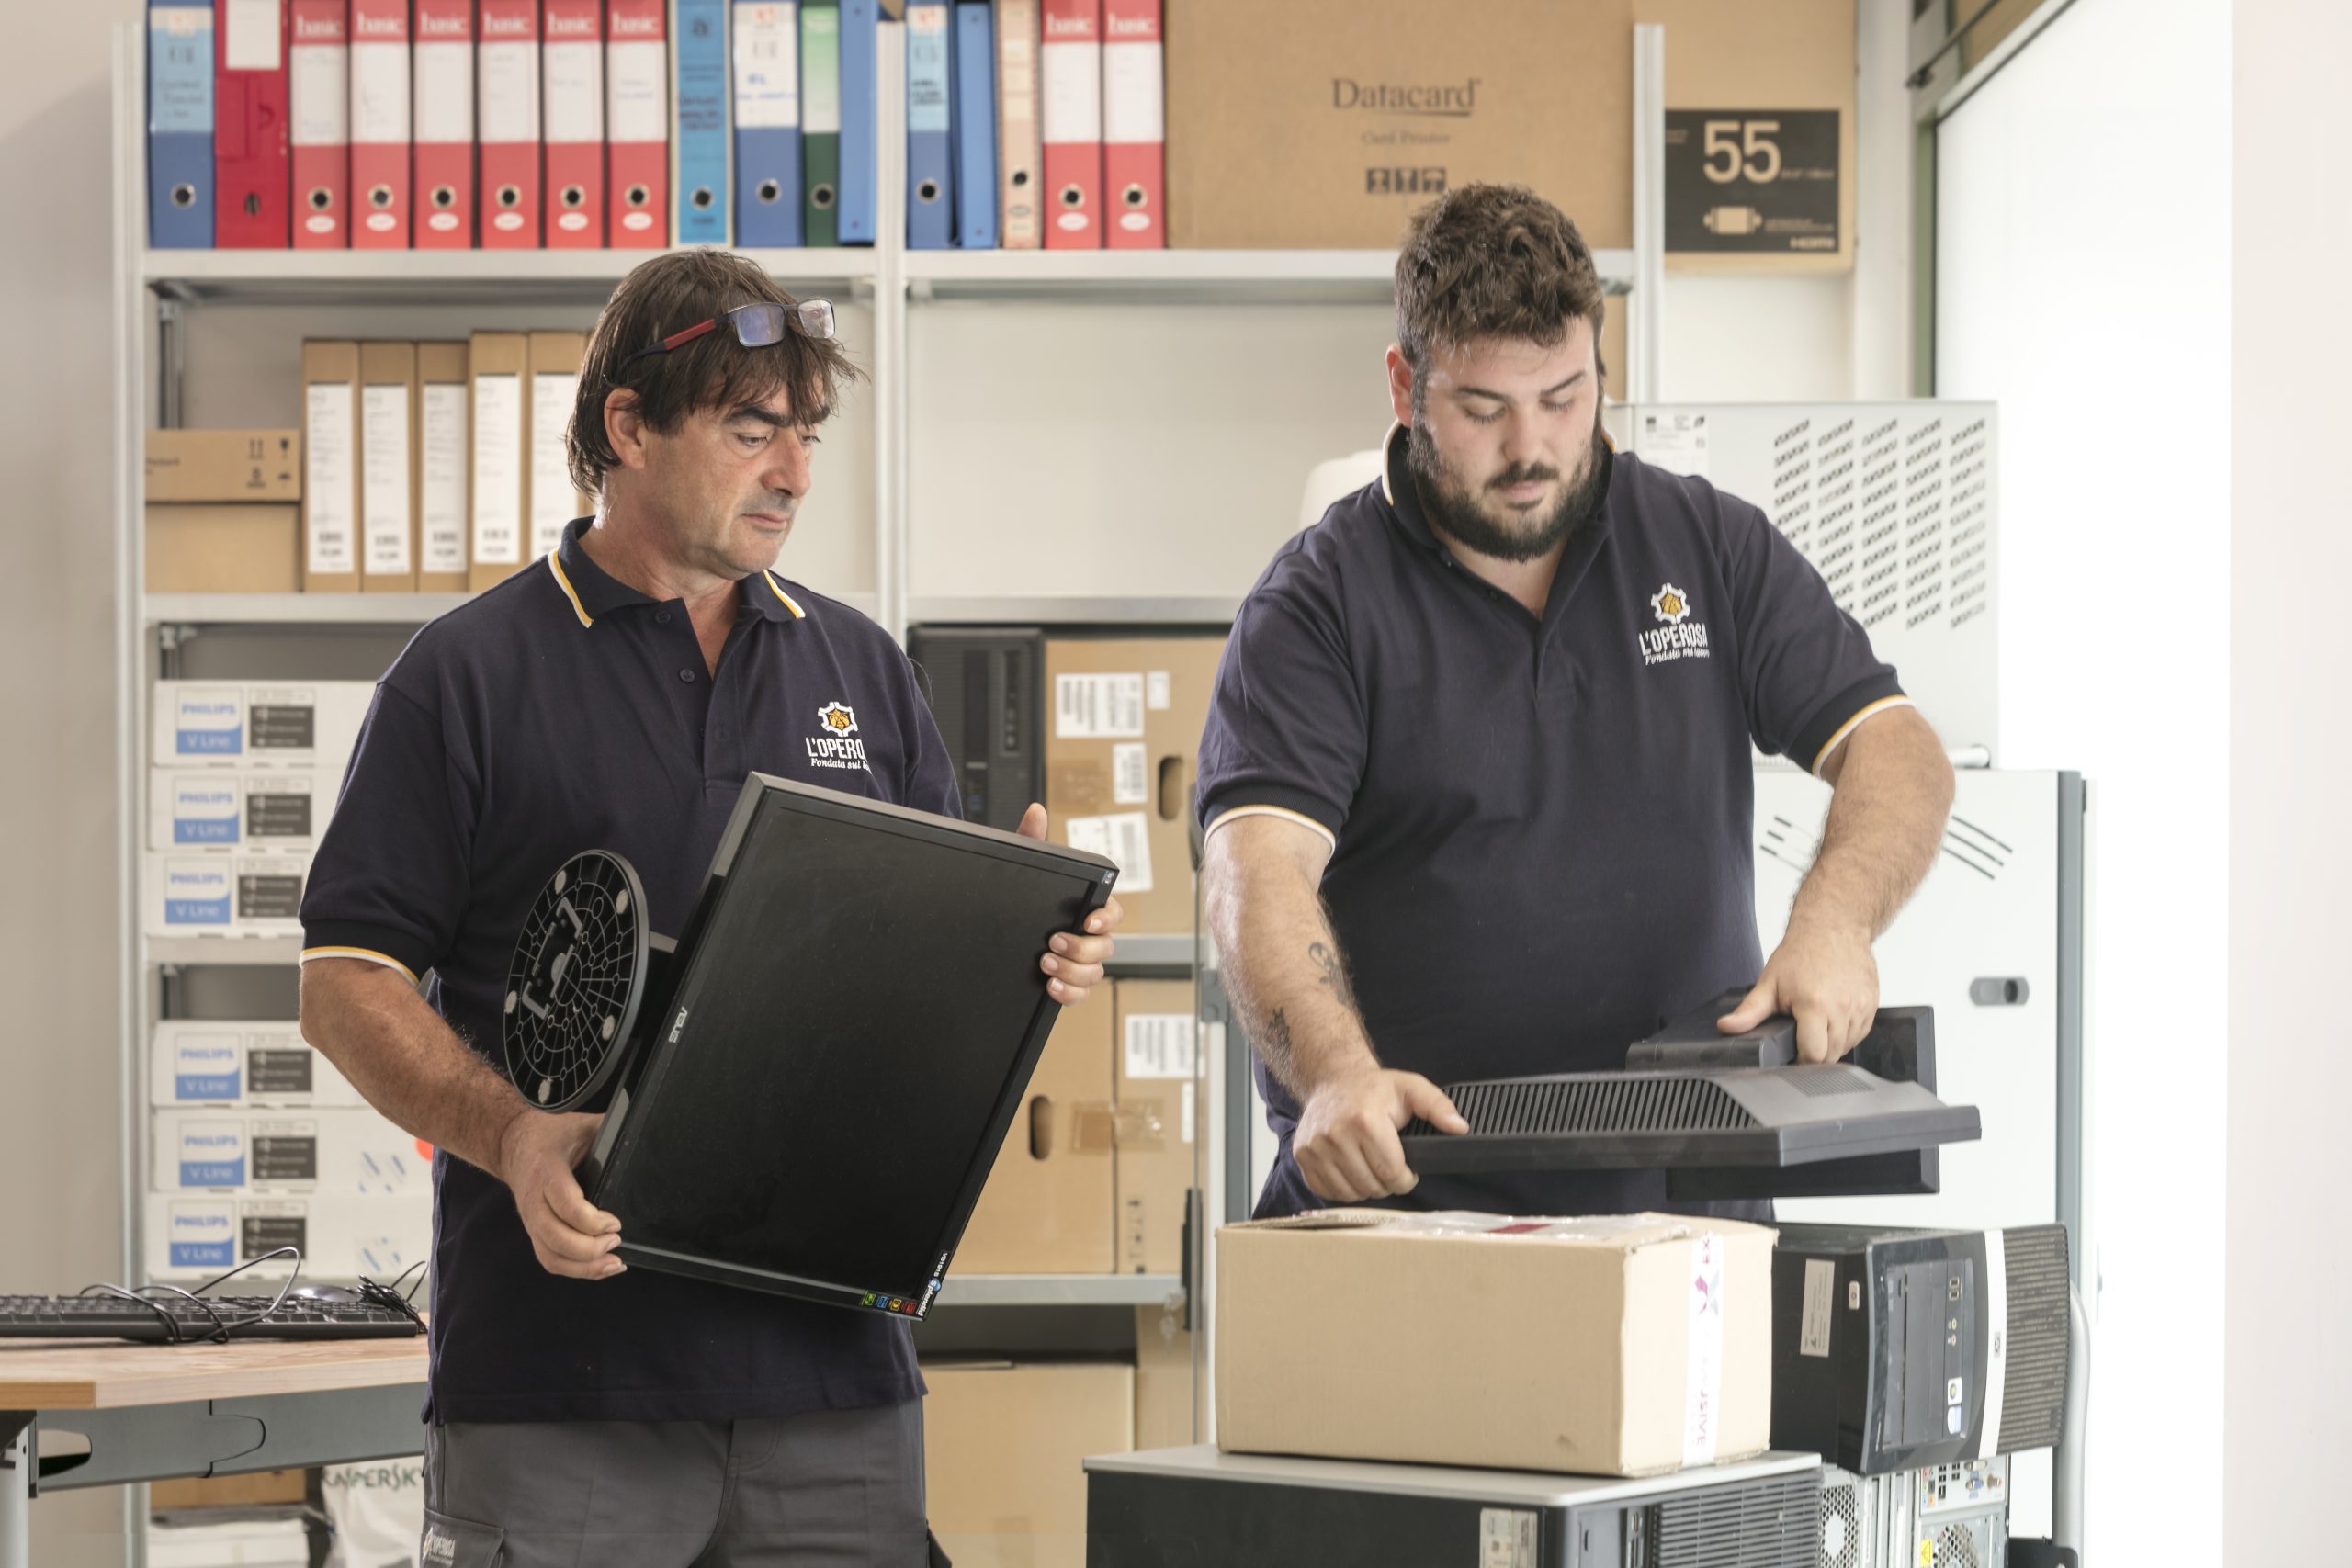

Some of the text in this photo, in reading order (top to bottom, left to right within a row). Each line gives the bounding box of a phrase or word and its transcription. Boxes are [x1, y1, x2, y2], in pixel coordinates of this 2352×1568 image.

[1331, 76, 1476, 110] Datacard
[1703, 120, 1781, 184] 55
[1638, 622, 1709, 657] L'OPEROSA
[182, 703, 236, 716] PHILIPS
[186, 734, 231, 749] V Line
[805, 737, 865, 760] L'OPERO
[810, 758, 846, 769] Fondata
[847, 761, 862, 770] sul
[179, 792, 233, 805] PHILIPS
[184, 823, 229, 837] V Line
[170, 873, 224, 886] PHILIPS
[175, 903, 220, 917] V Line
[668, 1006, 688, 1043] ASUS
[180, 1047, 234, 1060] PHILIPS
[185, 1078, 229, 1093] V Line
[184, 1135, 239, 1147] PHILIPS
[189, 1165, 233, 1179] V Line
[175, 1215, 229, 1228] PHILIPS
[179, 1246, 223, 1259] V Line
